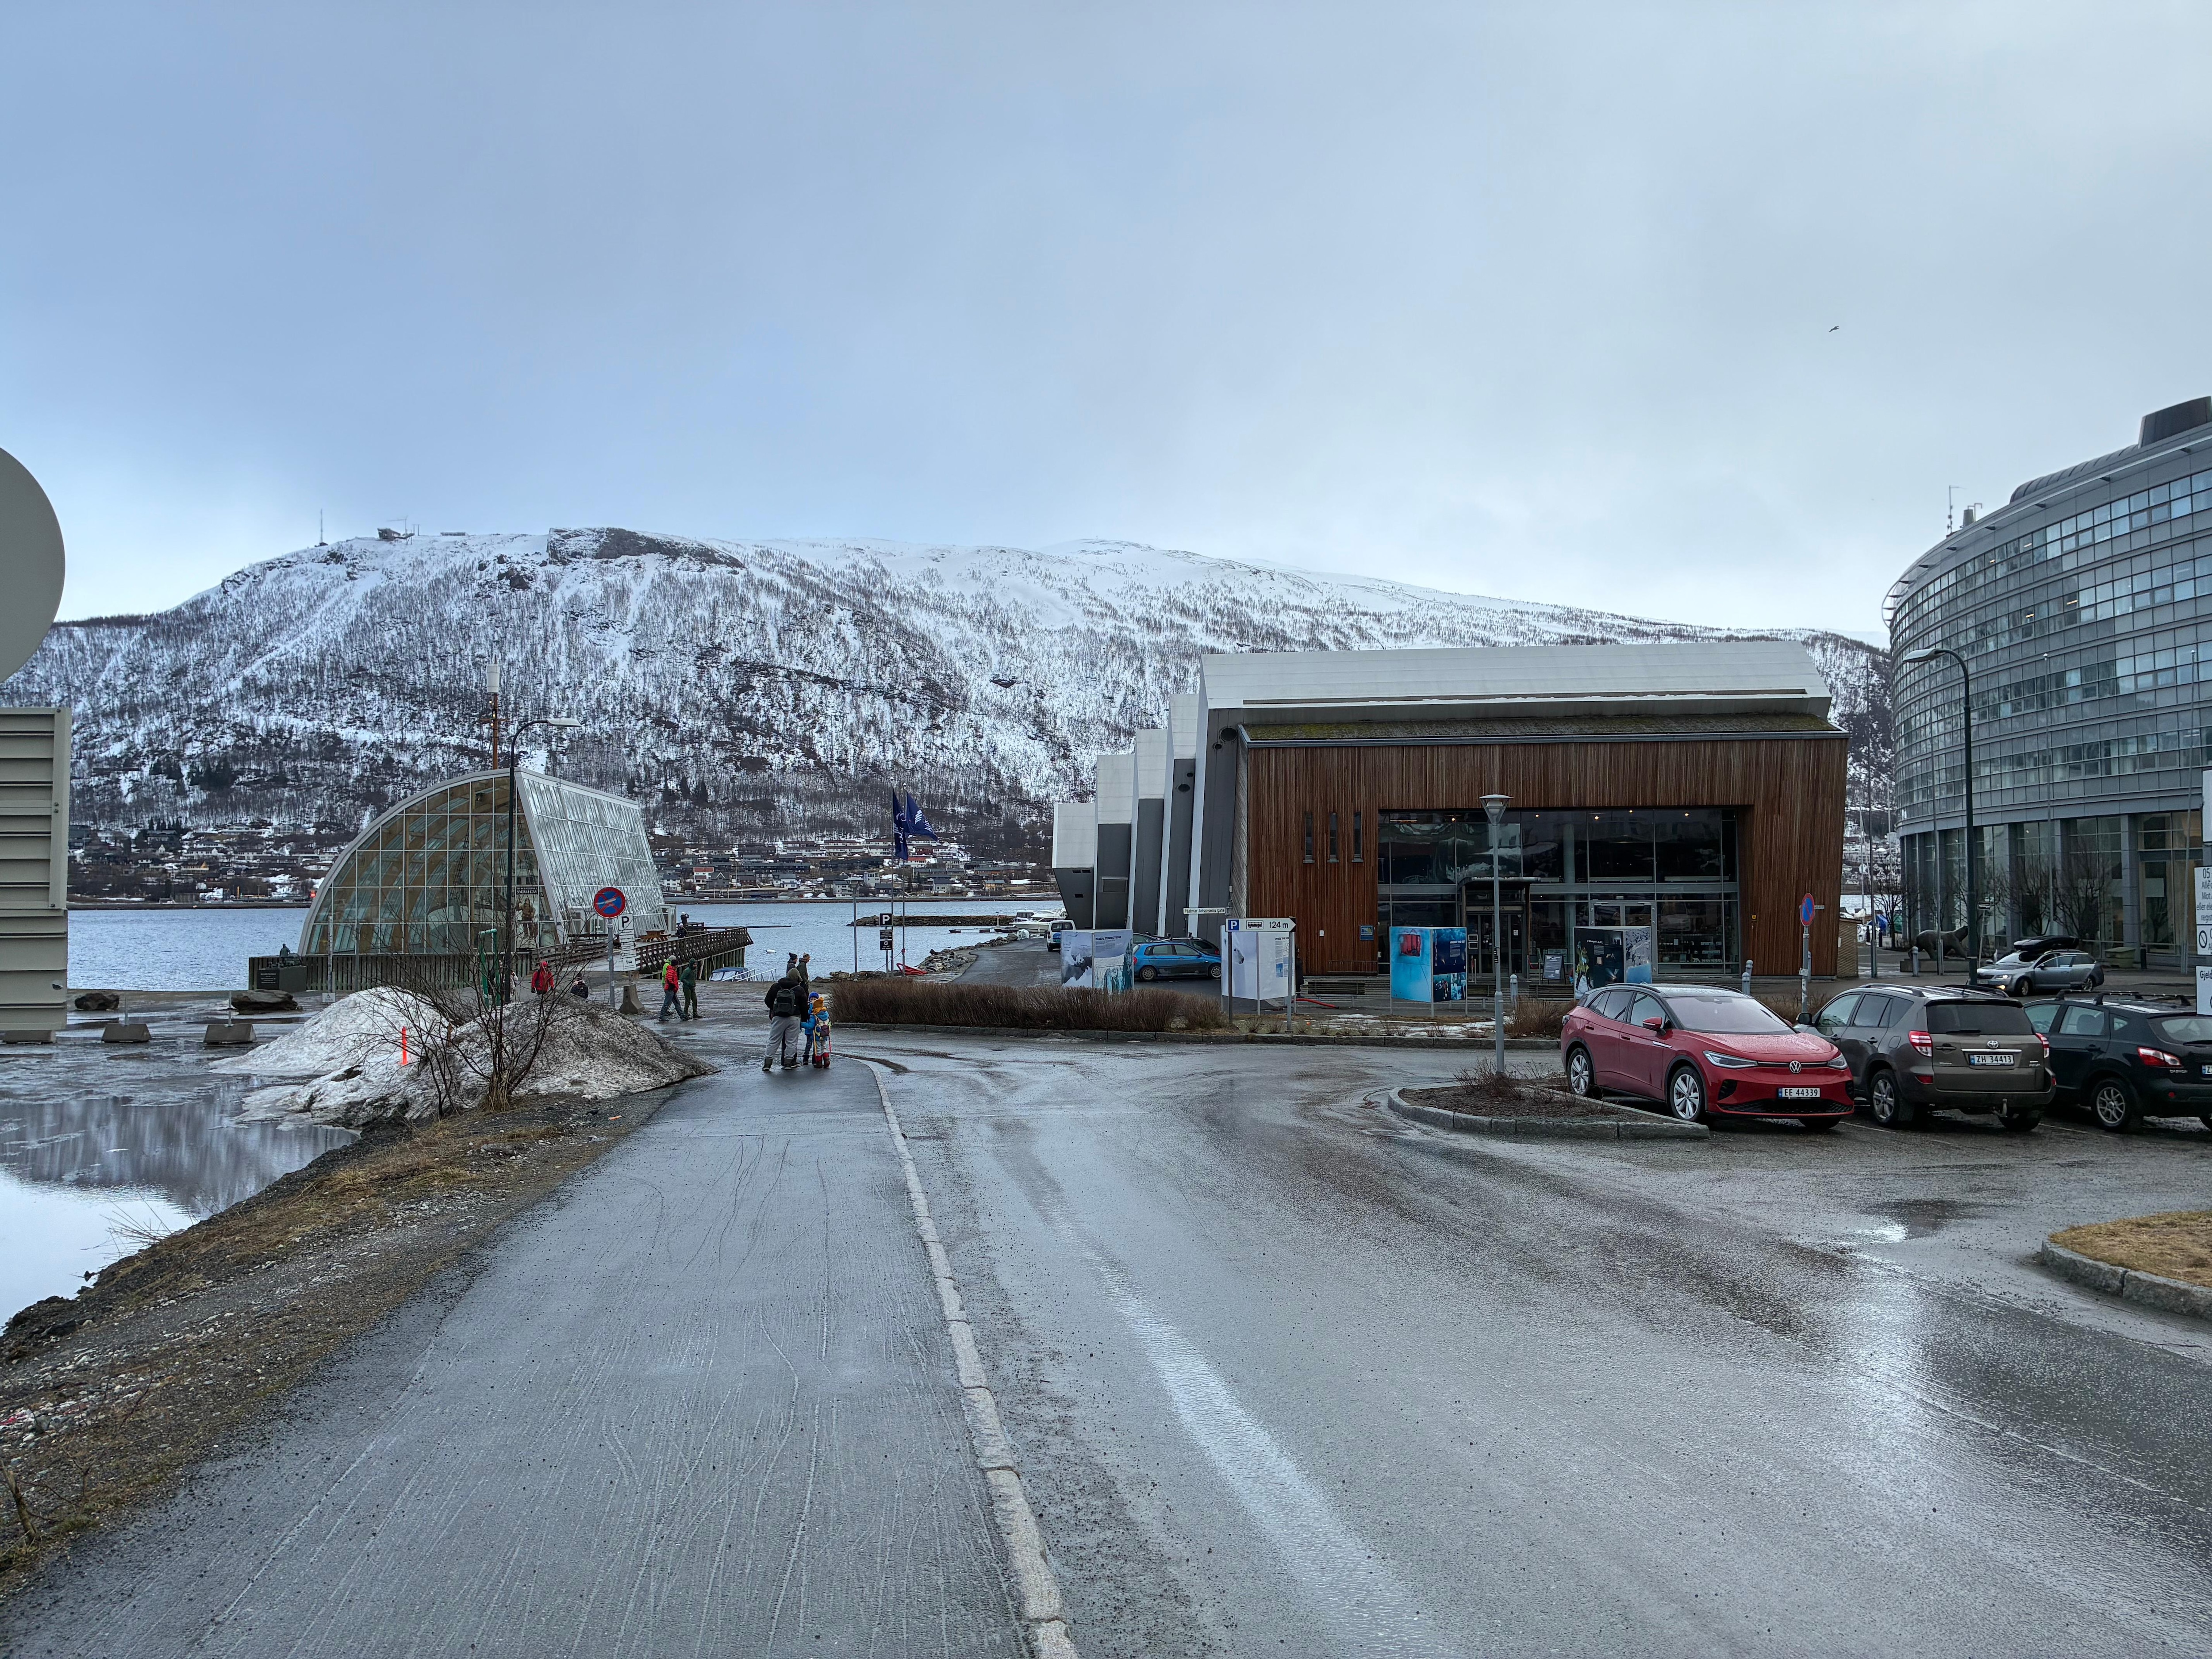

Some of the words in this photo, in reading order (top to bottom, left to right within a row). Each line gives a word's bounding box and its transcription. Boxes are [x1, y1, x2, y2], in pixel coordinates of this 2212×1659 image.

[2203, 868, 2210, 879] 05
[622, 916, 629, 929] P
[882, 914, 890, 924] P
